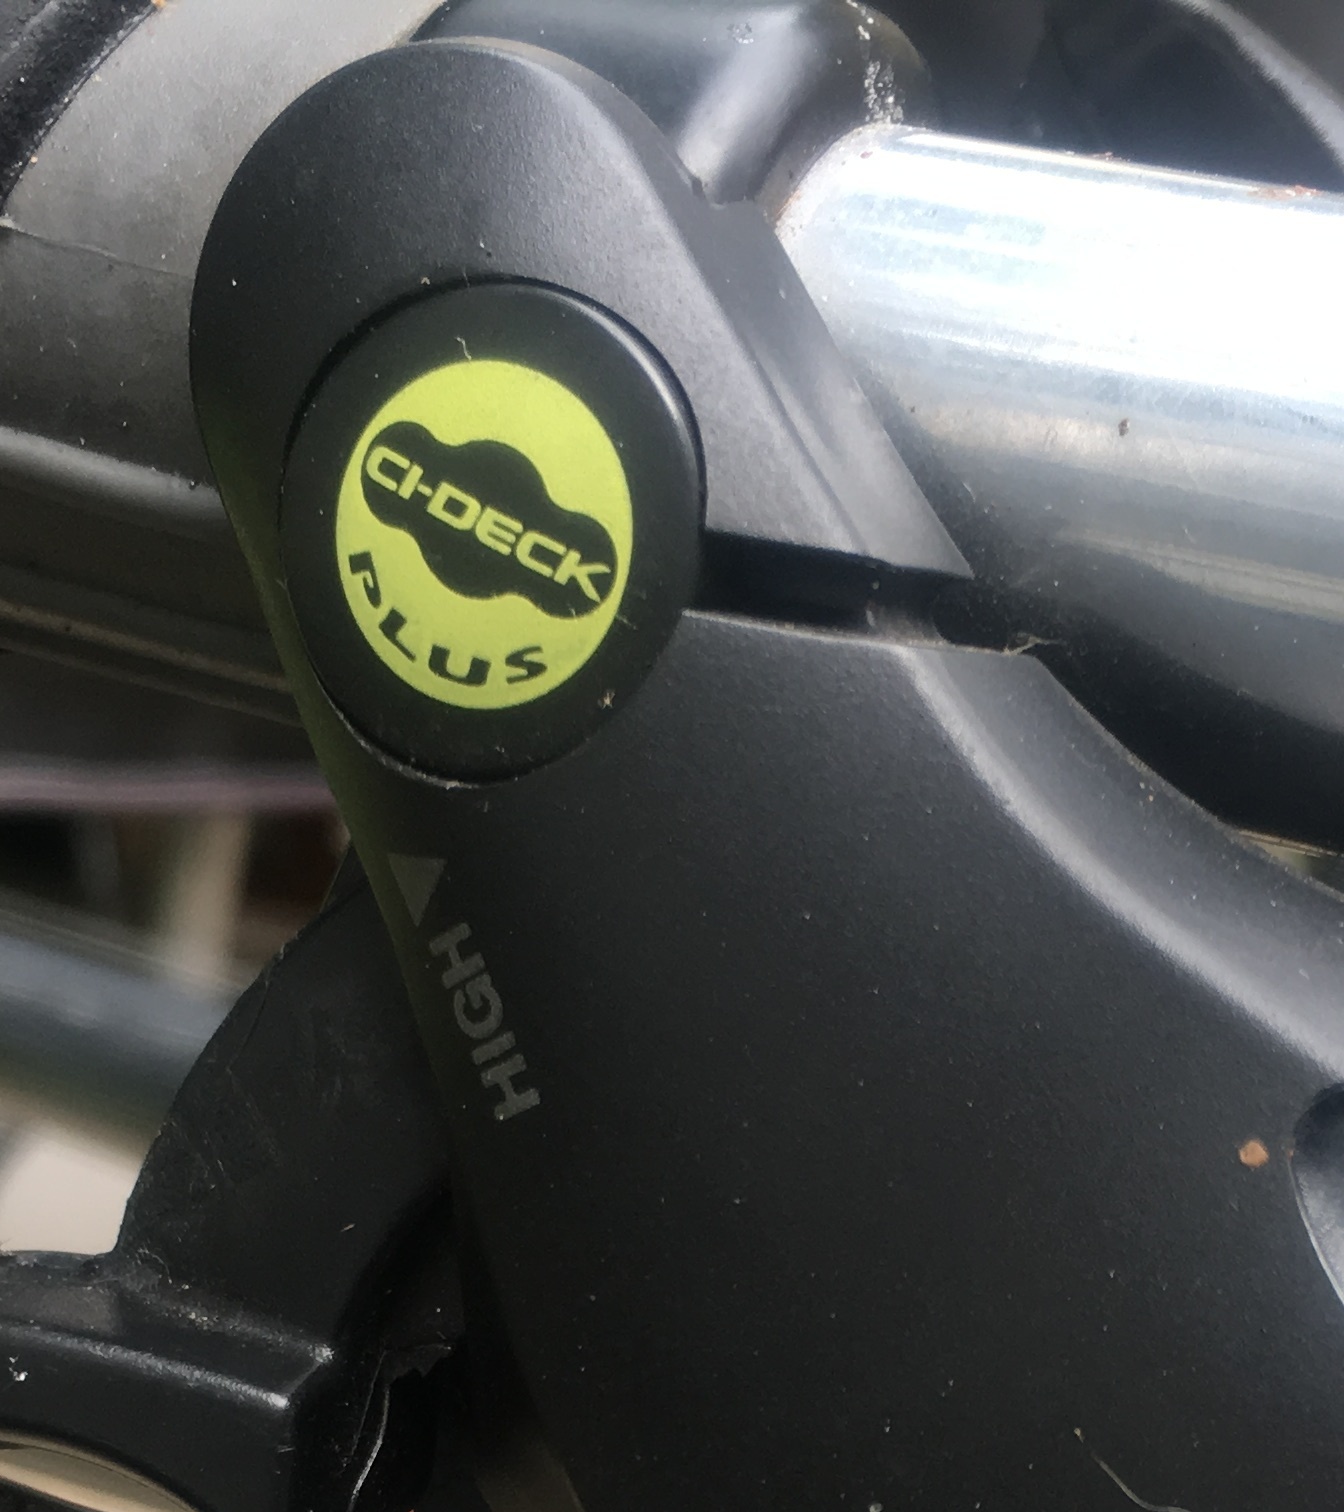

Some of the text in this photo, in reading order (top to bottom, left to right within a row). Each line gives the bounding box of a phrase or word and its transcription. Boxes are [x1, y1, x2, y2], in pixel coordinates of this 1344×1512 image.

[366, 446, 612, 603] CI-DECK
[349, 551, 548, 687] PLUS
[429, 922, 541, 1121] HIGH
